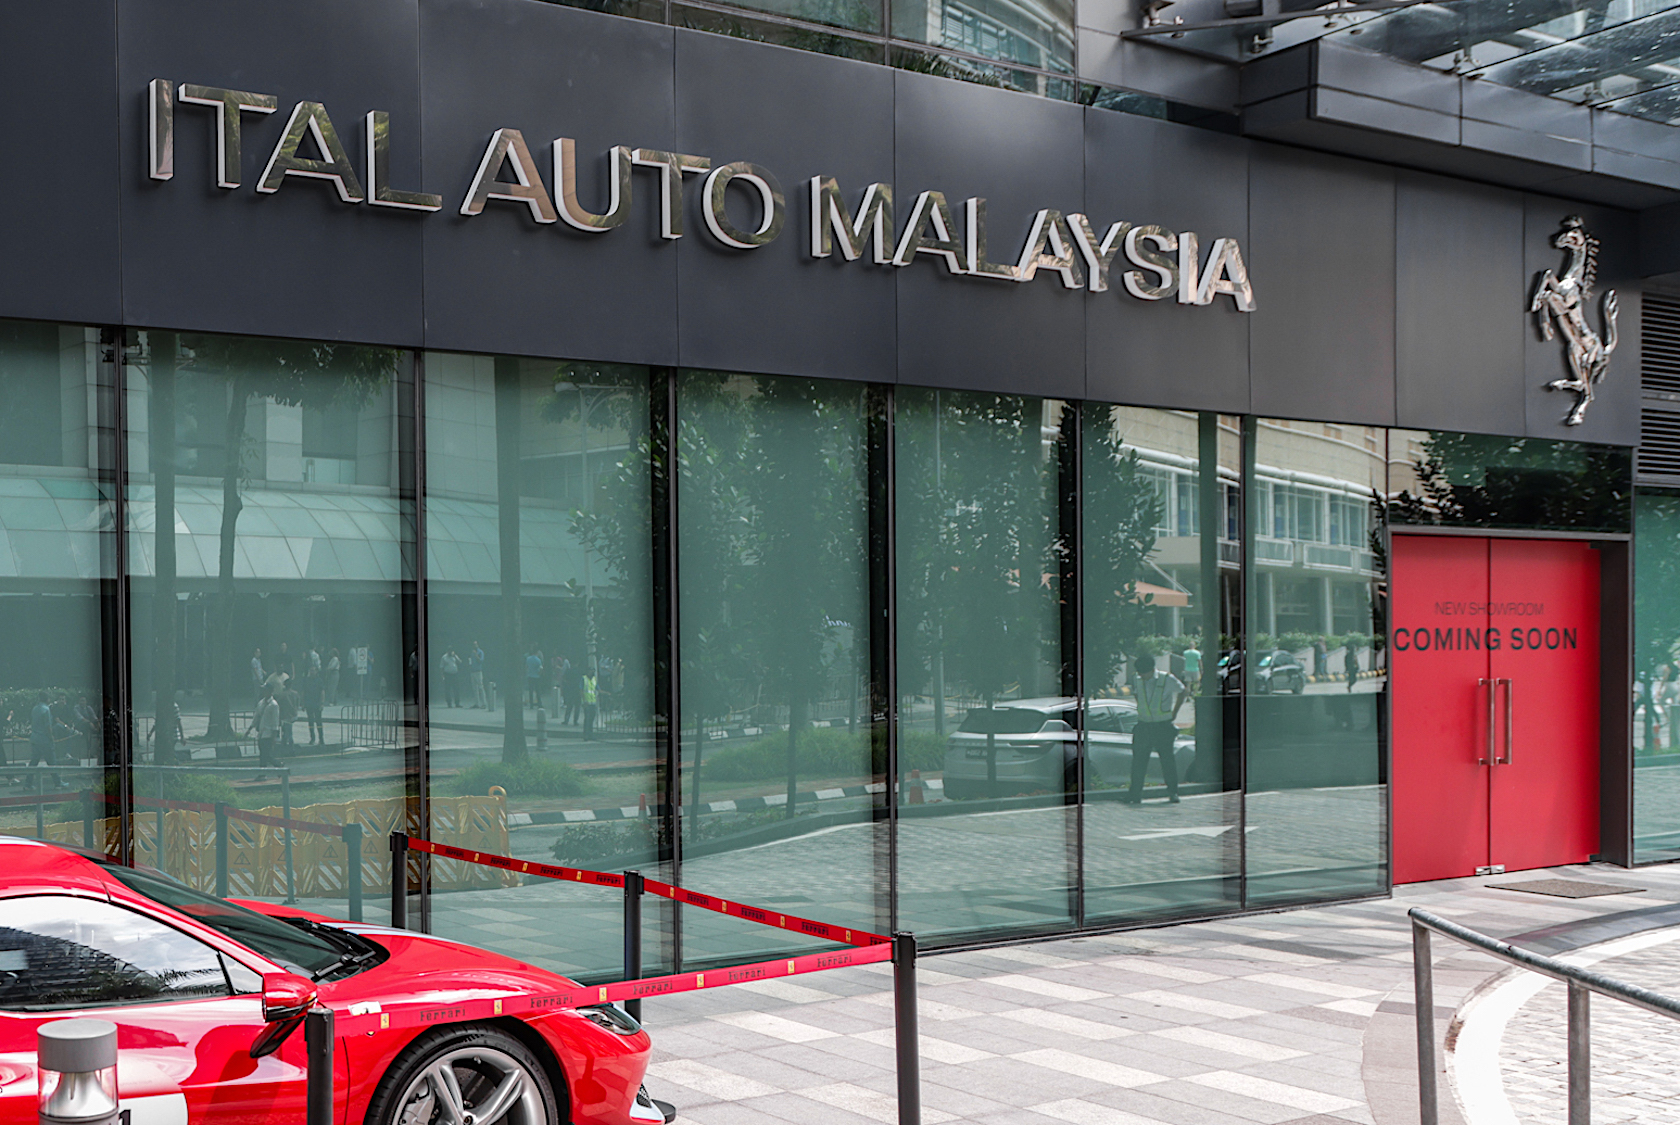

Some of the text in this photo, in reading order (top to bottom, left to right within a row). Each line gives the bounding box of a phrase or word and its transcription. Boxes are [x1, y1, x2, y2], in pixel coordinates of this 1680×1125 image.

[149, 78, 1256, 312] ITAL AUTO MALAYSIA
[1435, 602, 1544, 616] NEW SHOWROOM
[1394, 627, 1577, 651] COMING SOON
[801, 921, 829, 936] Ferrari
[420, 953, 852, 1022] Ferrari Ferrari Ferrari Ferrari Ferrari
